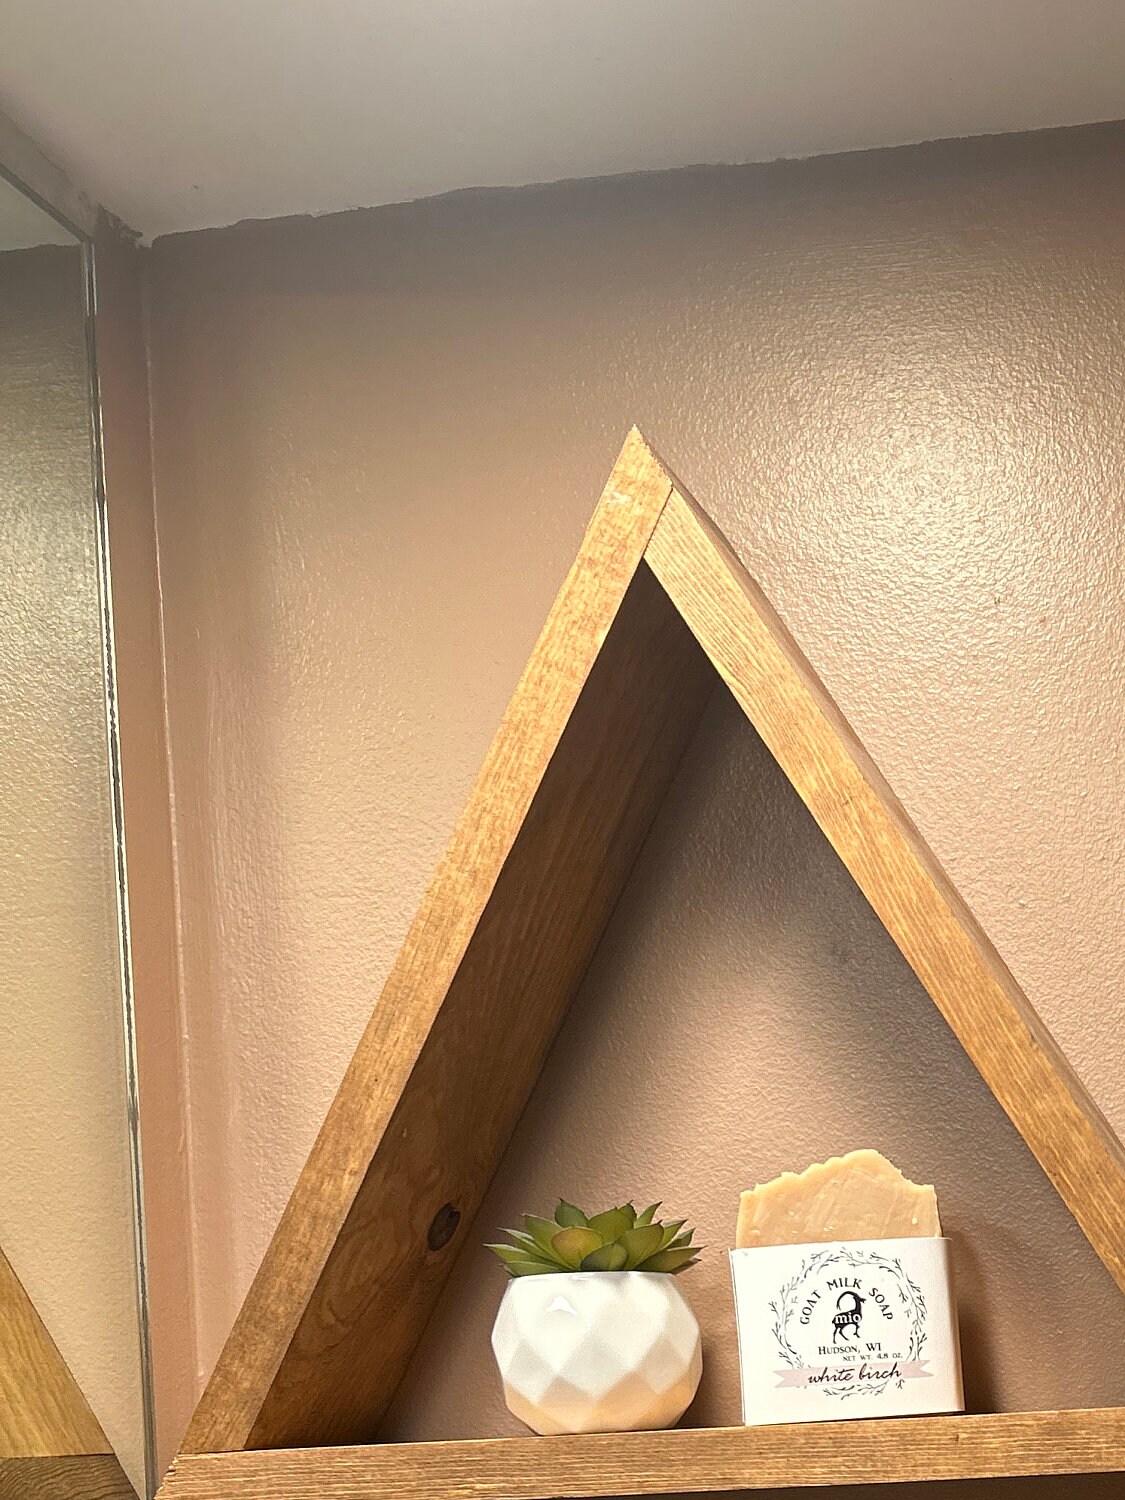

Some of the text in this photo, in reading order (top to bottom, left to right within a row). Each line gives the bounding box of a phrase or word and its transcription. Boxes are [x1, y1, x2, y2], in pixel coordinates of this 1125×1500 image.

[800, 1277, 894, 1324] GOAT MILK SOAP
[834, 1312, 862, 1324] mio
[818, 1342, 882, 1356] HUDSON, WI
[808, 1362, 902, 1384] white birch
